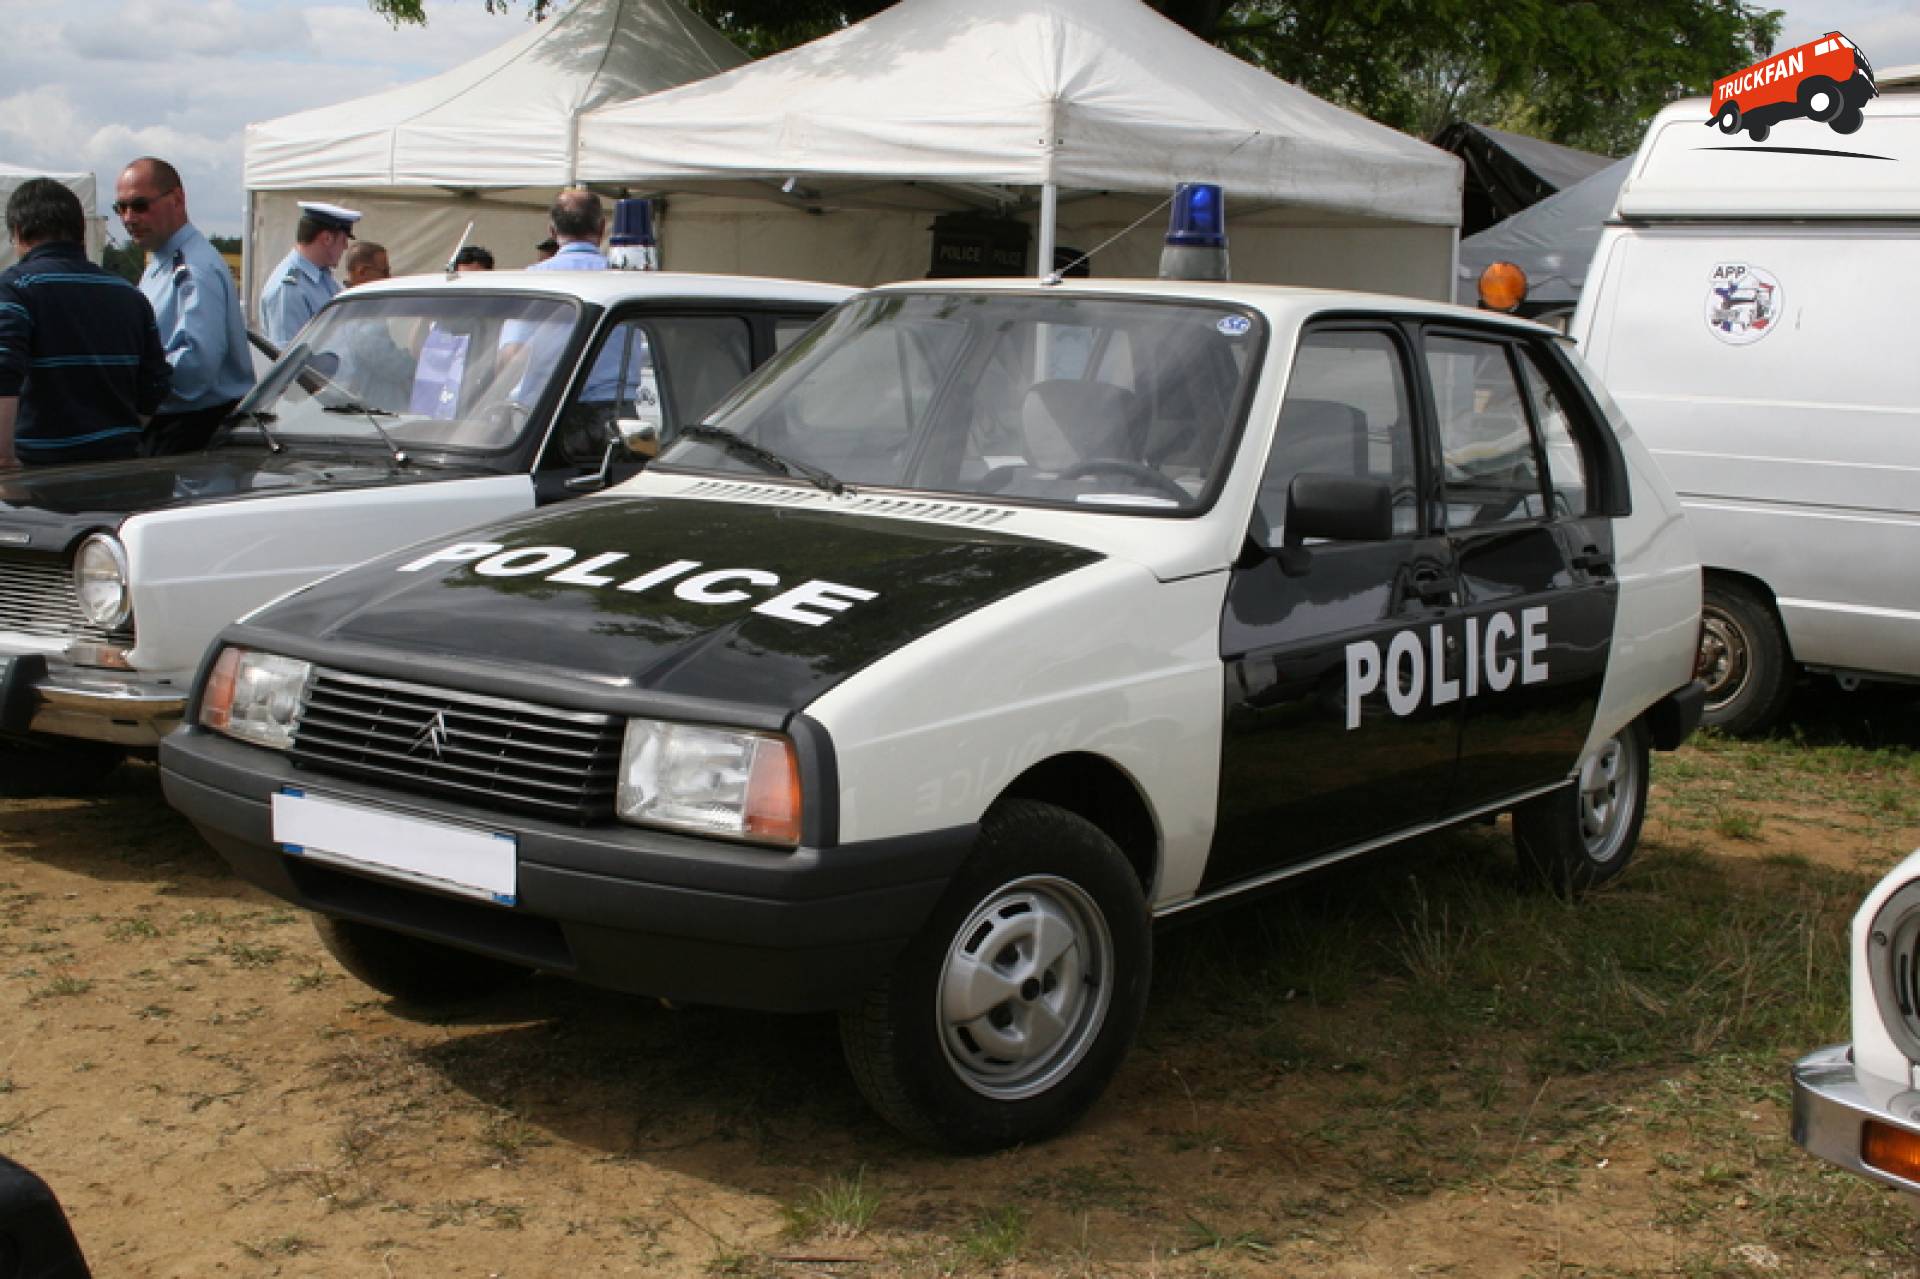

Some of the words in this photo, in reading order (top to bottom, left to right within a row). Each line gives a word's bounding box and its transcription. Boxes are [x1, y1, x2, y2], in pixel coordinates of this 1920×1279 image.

[940, 245, 981, 263] POLICE
[1713, 265, 1746, 279] APP
[396, 542, 879, 627] POLICE
[1346, 606, 1549, 730] POLICE
